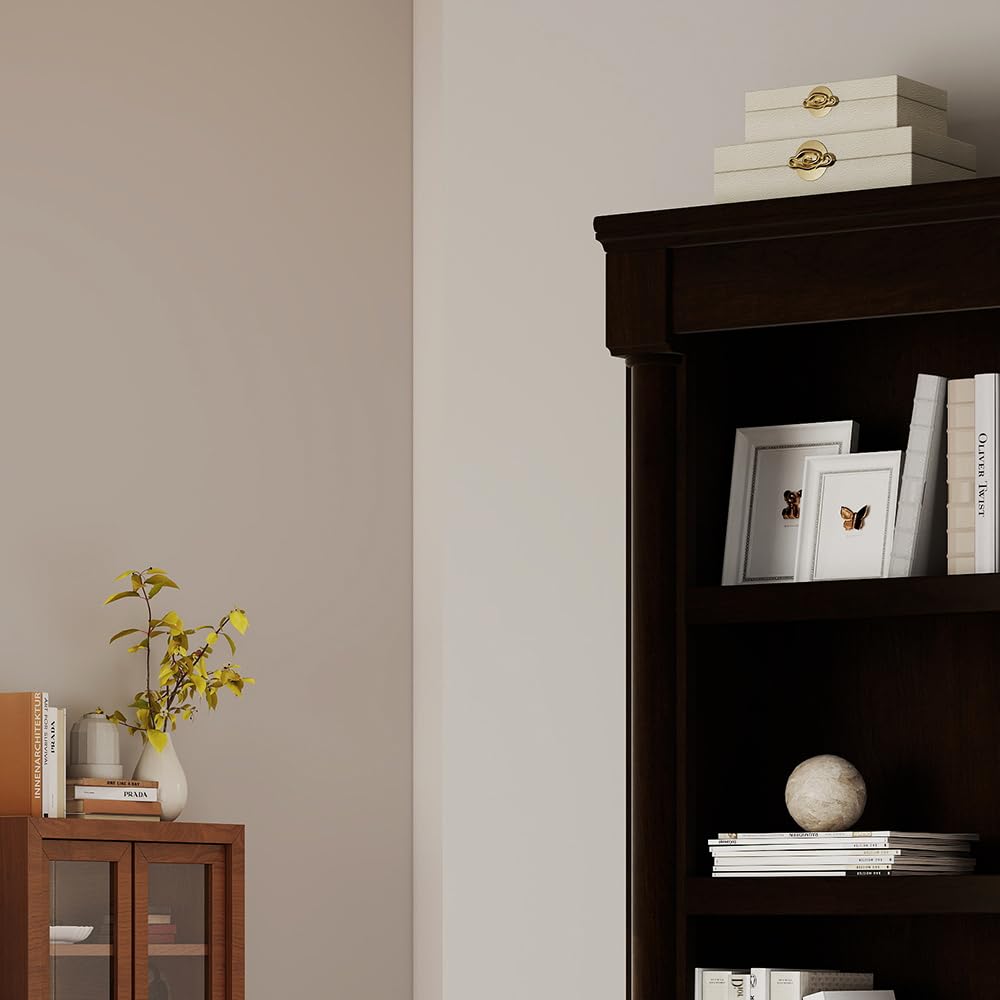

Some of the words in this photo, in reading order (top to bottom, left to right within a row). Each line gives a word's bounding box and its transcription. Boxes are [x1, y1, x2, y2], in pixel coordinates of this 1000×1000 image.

[978, 432, 988, 478] OLIVER
[978, 480, 988, 518] TWIST
[34, 692, 42, 799] INNENARCHITEKTUR
